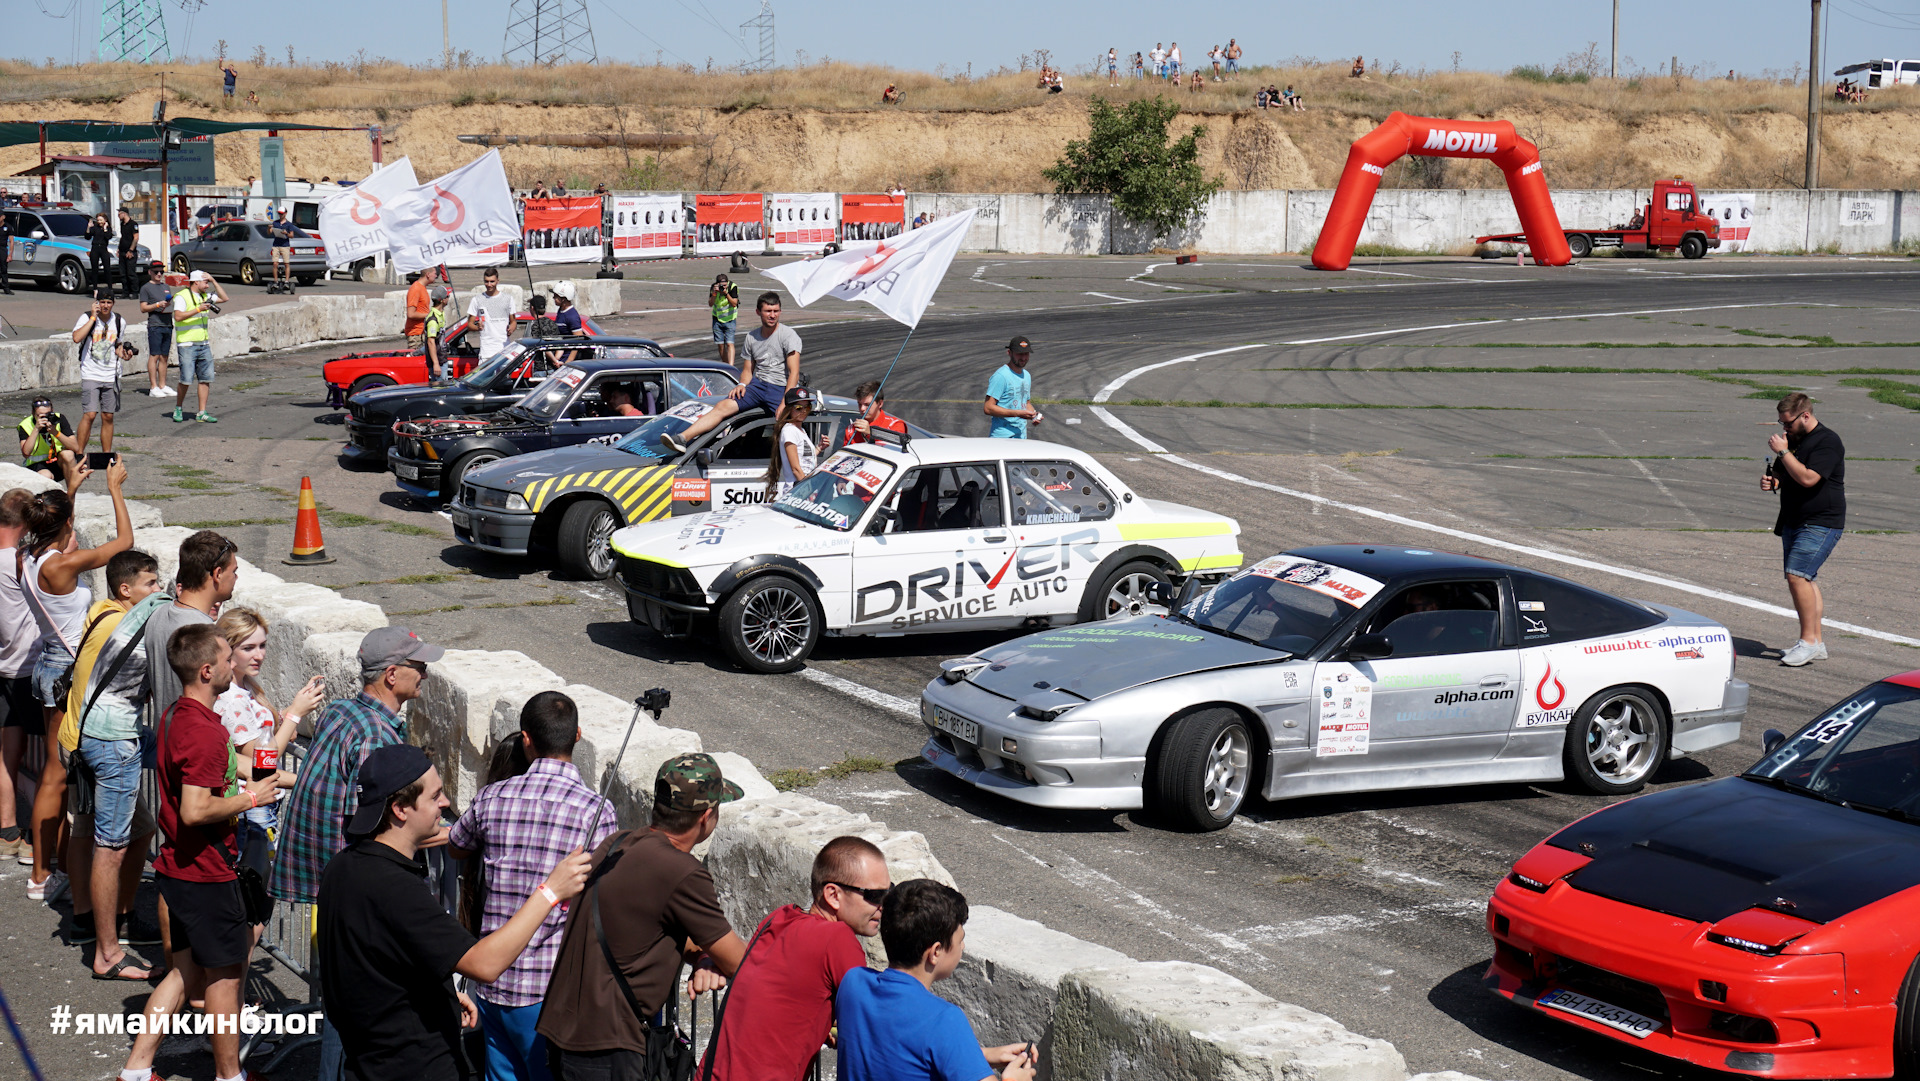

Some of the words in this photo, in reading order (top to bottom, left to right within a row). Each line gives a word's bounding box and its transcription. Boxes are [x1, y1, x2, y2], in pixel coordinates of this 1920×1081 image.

[1423, 128, 1498, 153] MOTUL
[1361, 163, 1384, 176] MOTU
[1850, 210, 1874, 221] ПАРК
[723, 487, 779, 505] Schulz
[1322, 580, 1367, 599] MAXXIS
[892, 593, 997, 630] SERVICE
[1009, 575, 1068, 606] AUTO
[1584, 633, 1726, 654] www.btc-alpha.com
[1378, 673, 1463, 688] #GODZILLARACING
[1434, 689, 1514, 705] alpha.com
[1527, 708, 1574, 726] ВУЛКАН
[965, 723, 976, 740] BA
[1804, 718, 1851, 742] 14
[1553, 993, 1585, 1009] BH
[1583, 1002, 1623, 1022] 1345
[1619, 1014, 1652, 1032] HO
